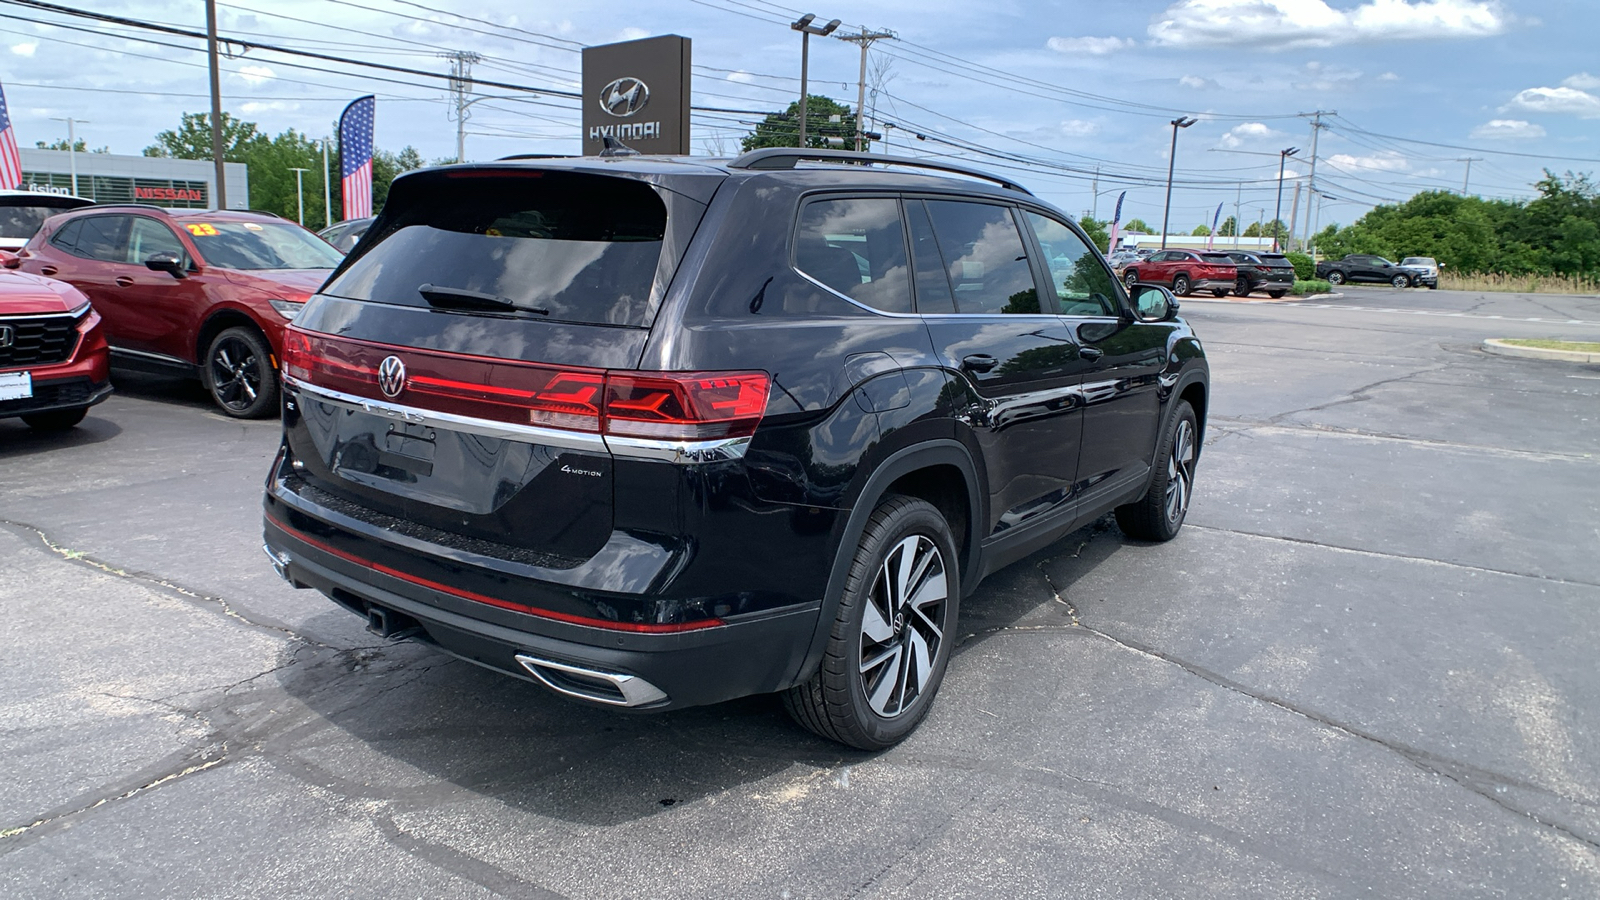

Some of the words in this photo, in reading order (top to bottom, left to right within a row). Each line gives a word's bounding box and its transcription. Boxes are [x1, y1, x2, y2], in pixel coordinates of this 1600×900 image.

[589, 121, 660, 142] HYUNDAI
[135, 187, 201, 200] NISSAN
[186, 223, 217, 236] 23
[363, 402, 425, 422] ATLAS
[561, 464, 602, 477] 4MOTION
